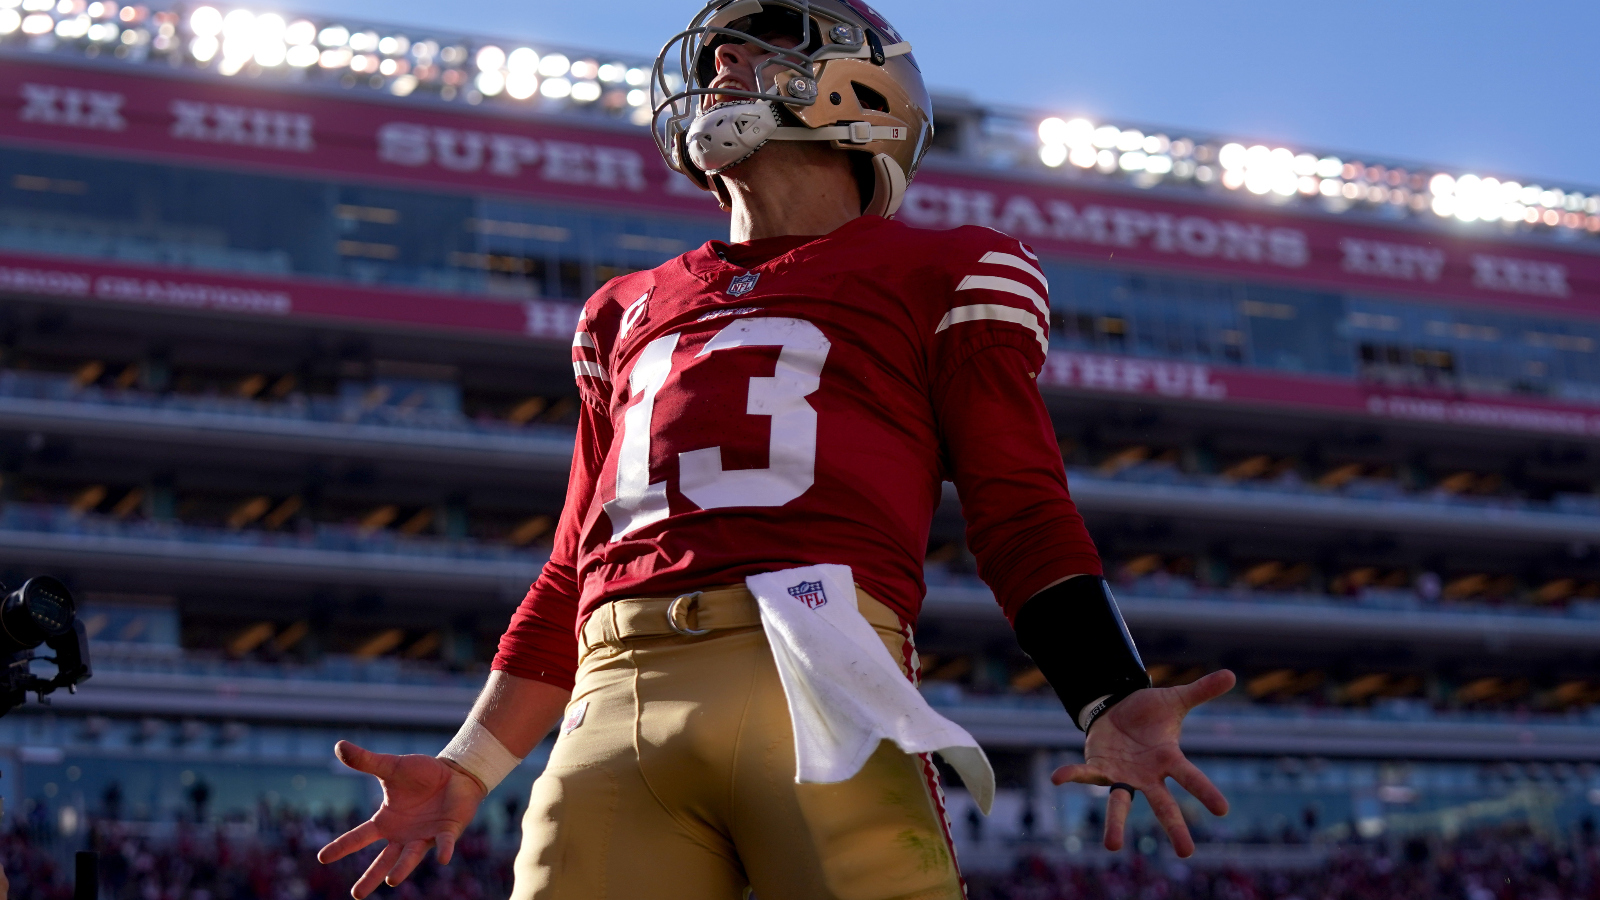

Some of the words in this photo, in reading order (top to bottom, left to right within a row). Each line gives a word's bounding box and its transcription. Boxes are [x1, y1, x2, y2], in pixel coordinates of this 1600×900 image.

[19, 82, 127, 132] XIX
[170, 100, 315, 152] XXIII
[377, 121, 646, 192] SUPER
[902, 182, 1309, 268] CHAMPIONS
[892, 128, 899, 138] 13
[730, 282, 754, 293] NFL
[602, 317, 832, 543] 13
